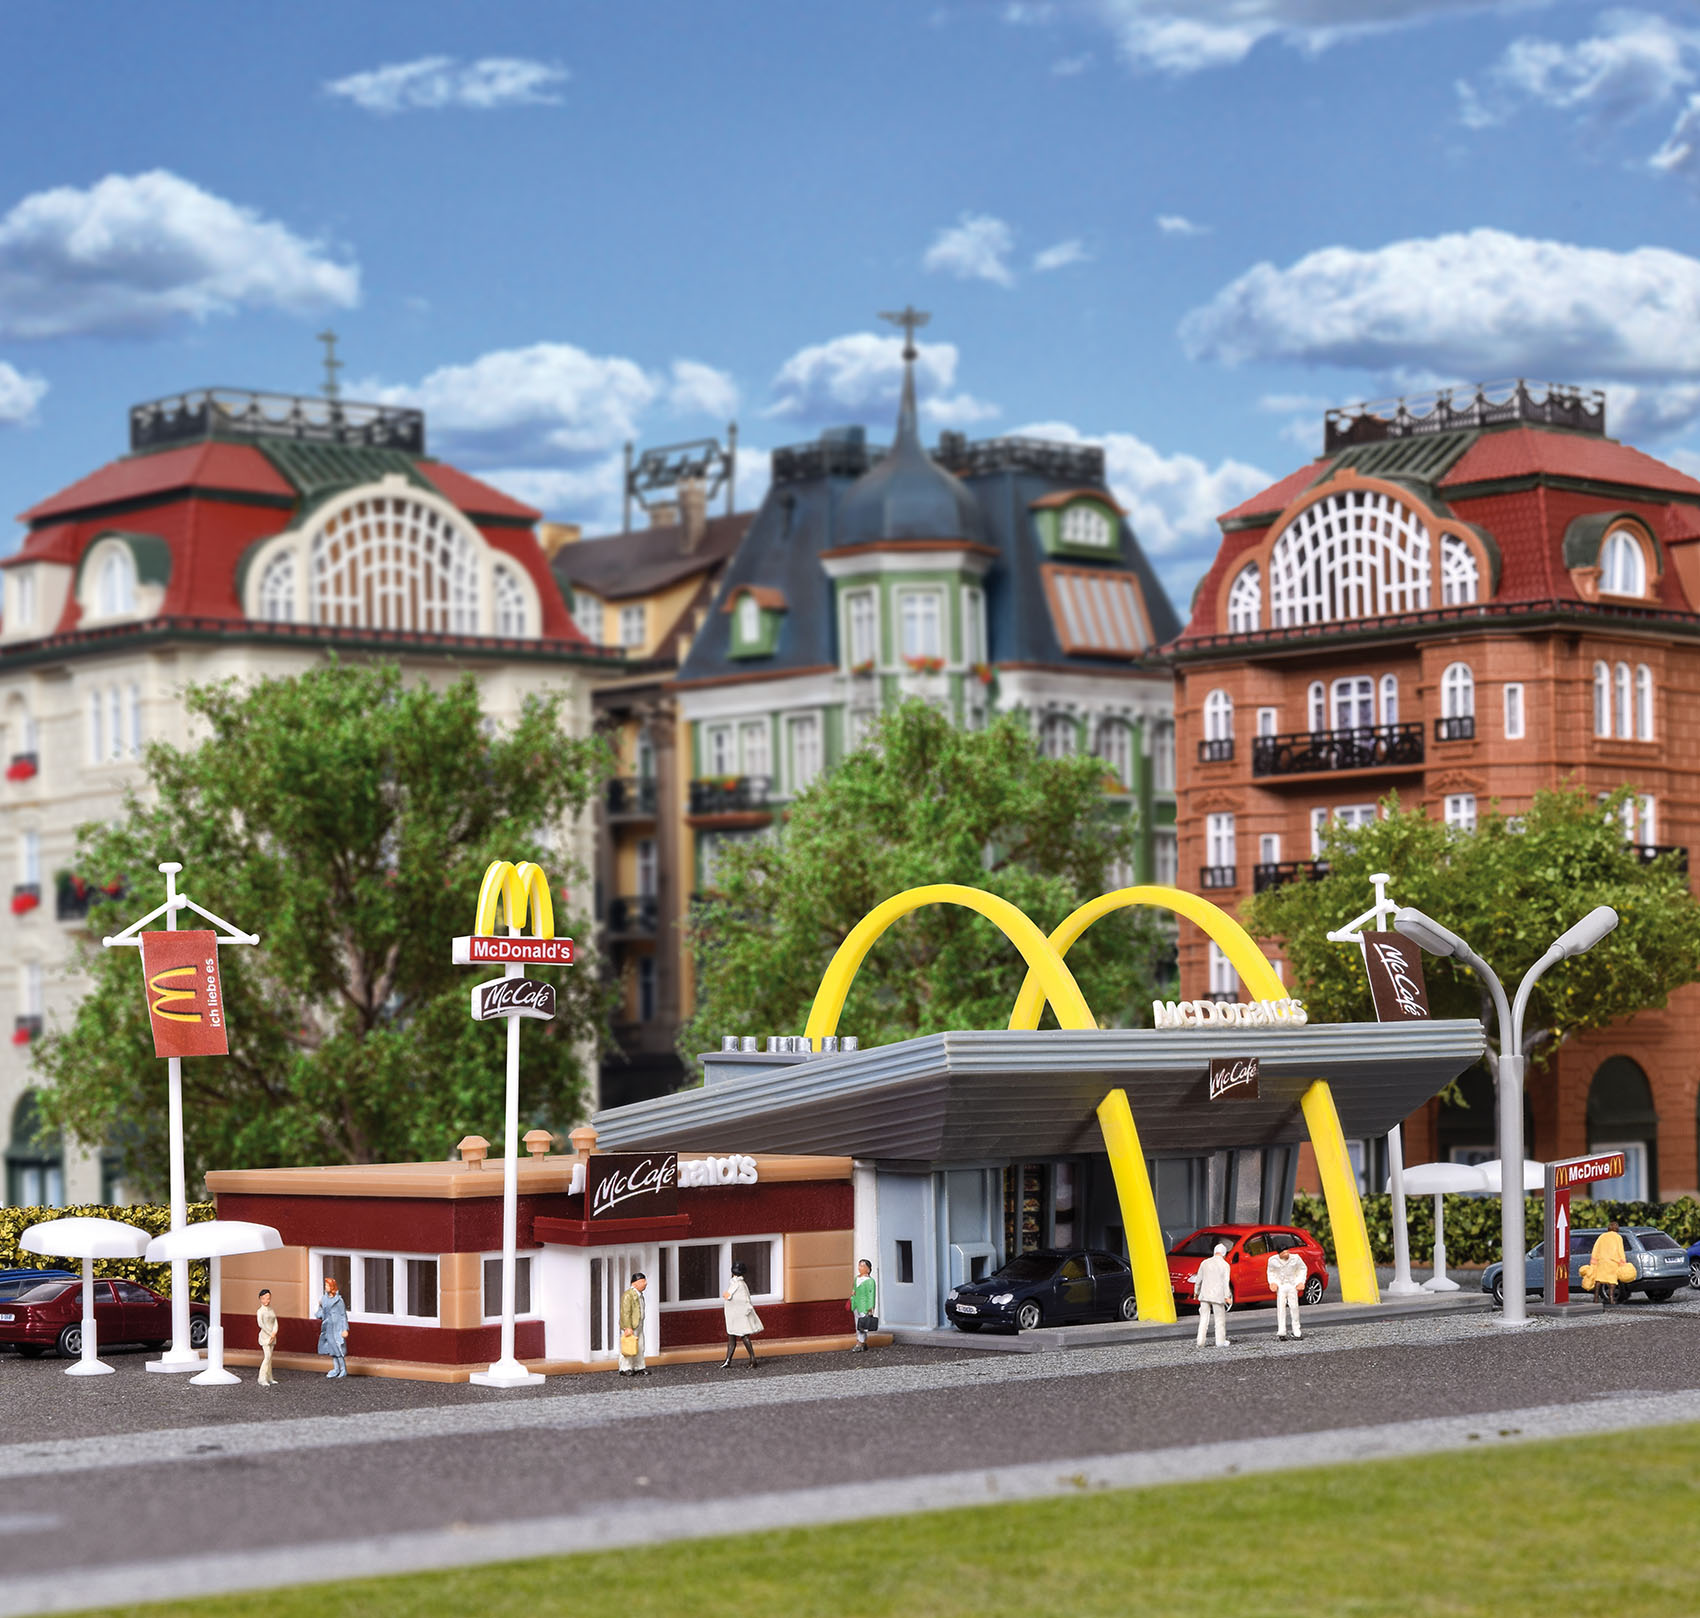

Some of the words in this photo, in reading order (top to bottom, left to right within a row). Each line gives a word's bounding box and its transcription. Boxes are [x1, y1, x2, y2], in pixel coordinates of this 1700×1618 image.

[205, 958, 214, 973] es
[474, 941, 571, 959] McDonald's
[206, 975, 218, 1007] liebe
[1379, 943, 1428, 1016] McCafé
[484, 981, 551, 1014] McCafé
[210, 1009, 221, 1028] ich
[1210, 1058, 1257, 1096] McCafé
[593, 1155, 677, 1209] McCafé
[1568, 1162, 1610, 1182] McDrive
